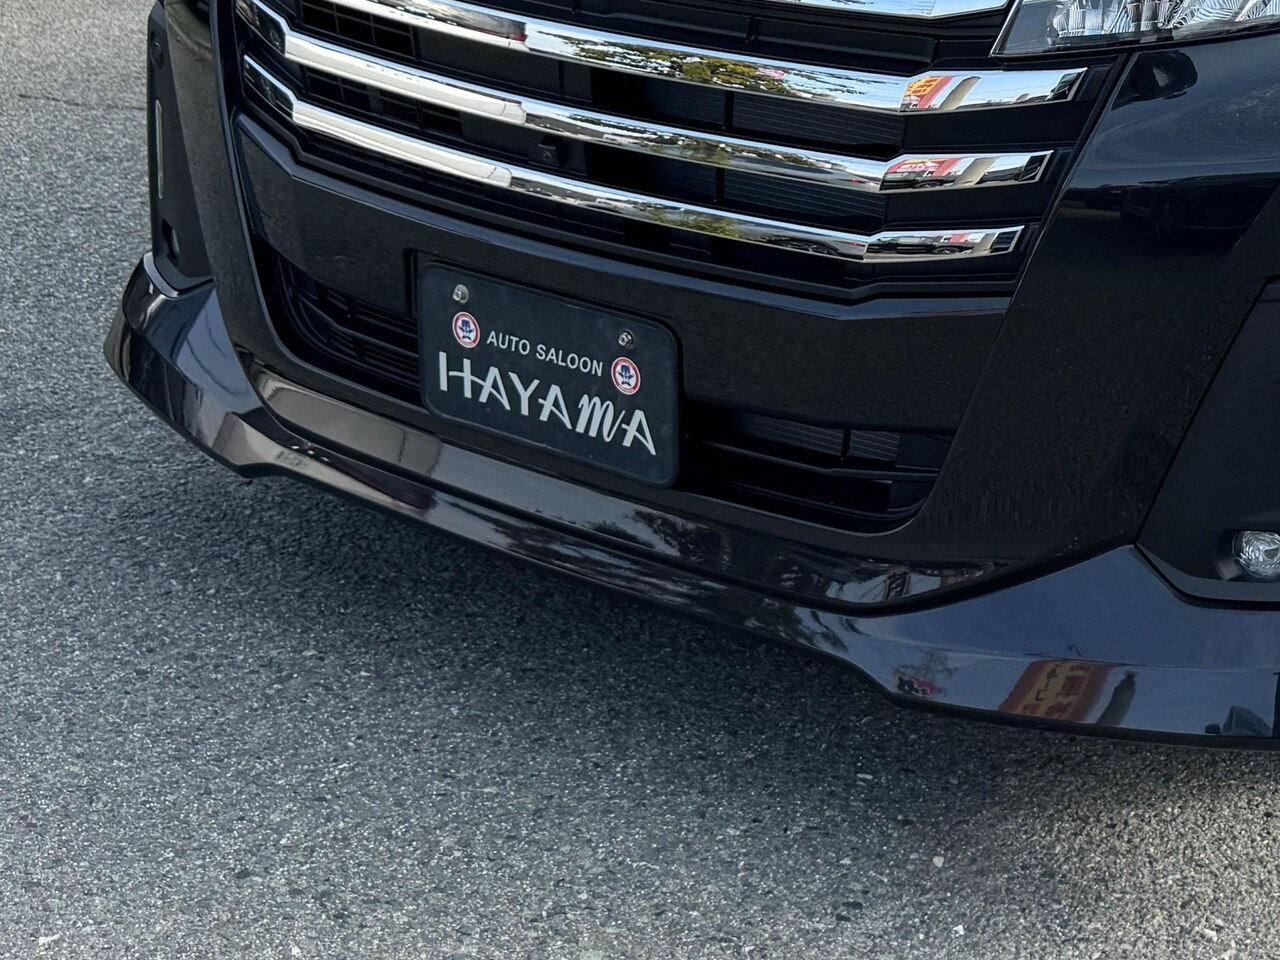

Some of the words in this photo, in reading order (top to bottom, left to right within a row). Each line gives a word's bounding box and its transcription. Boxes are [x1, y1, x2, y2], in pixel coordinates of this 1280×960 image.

[486, 330, 530, 356] AUTO
[536, 344, 603, 377] SALOON
[438, 351, 657, 456] HAYAMA
